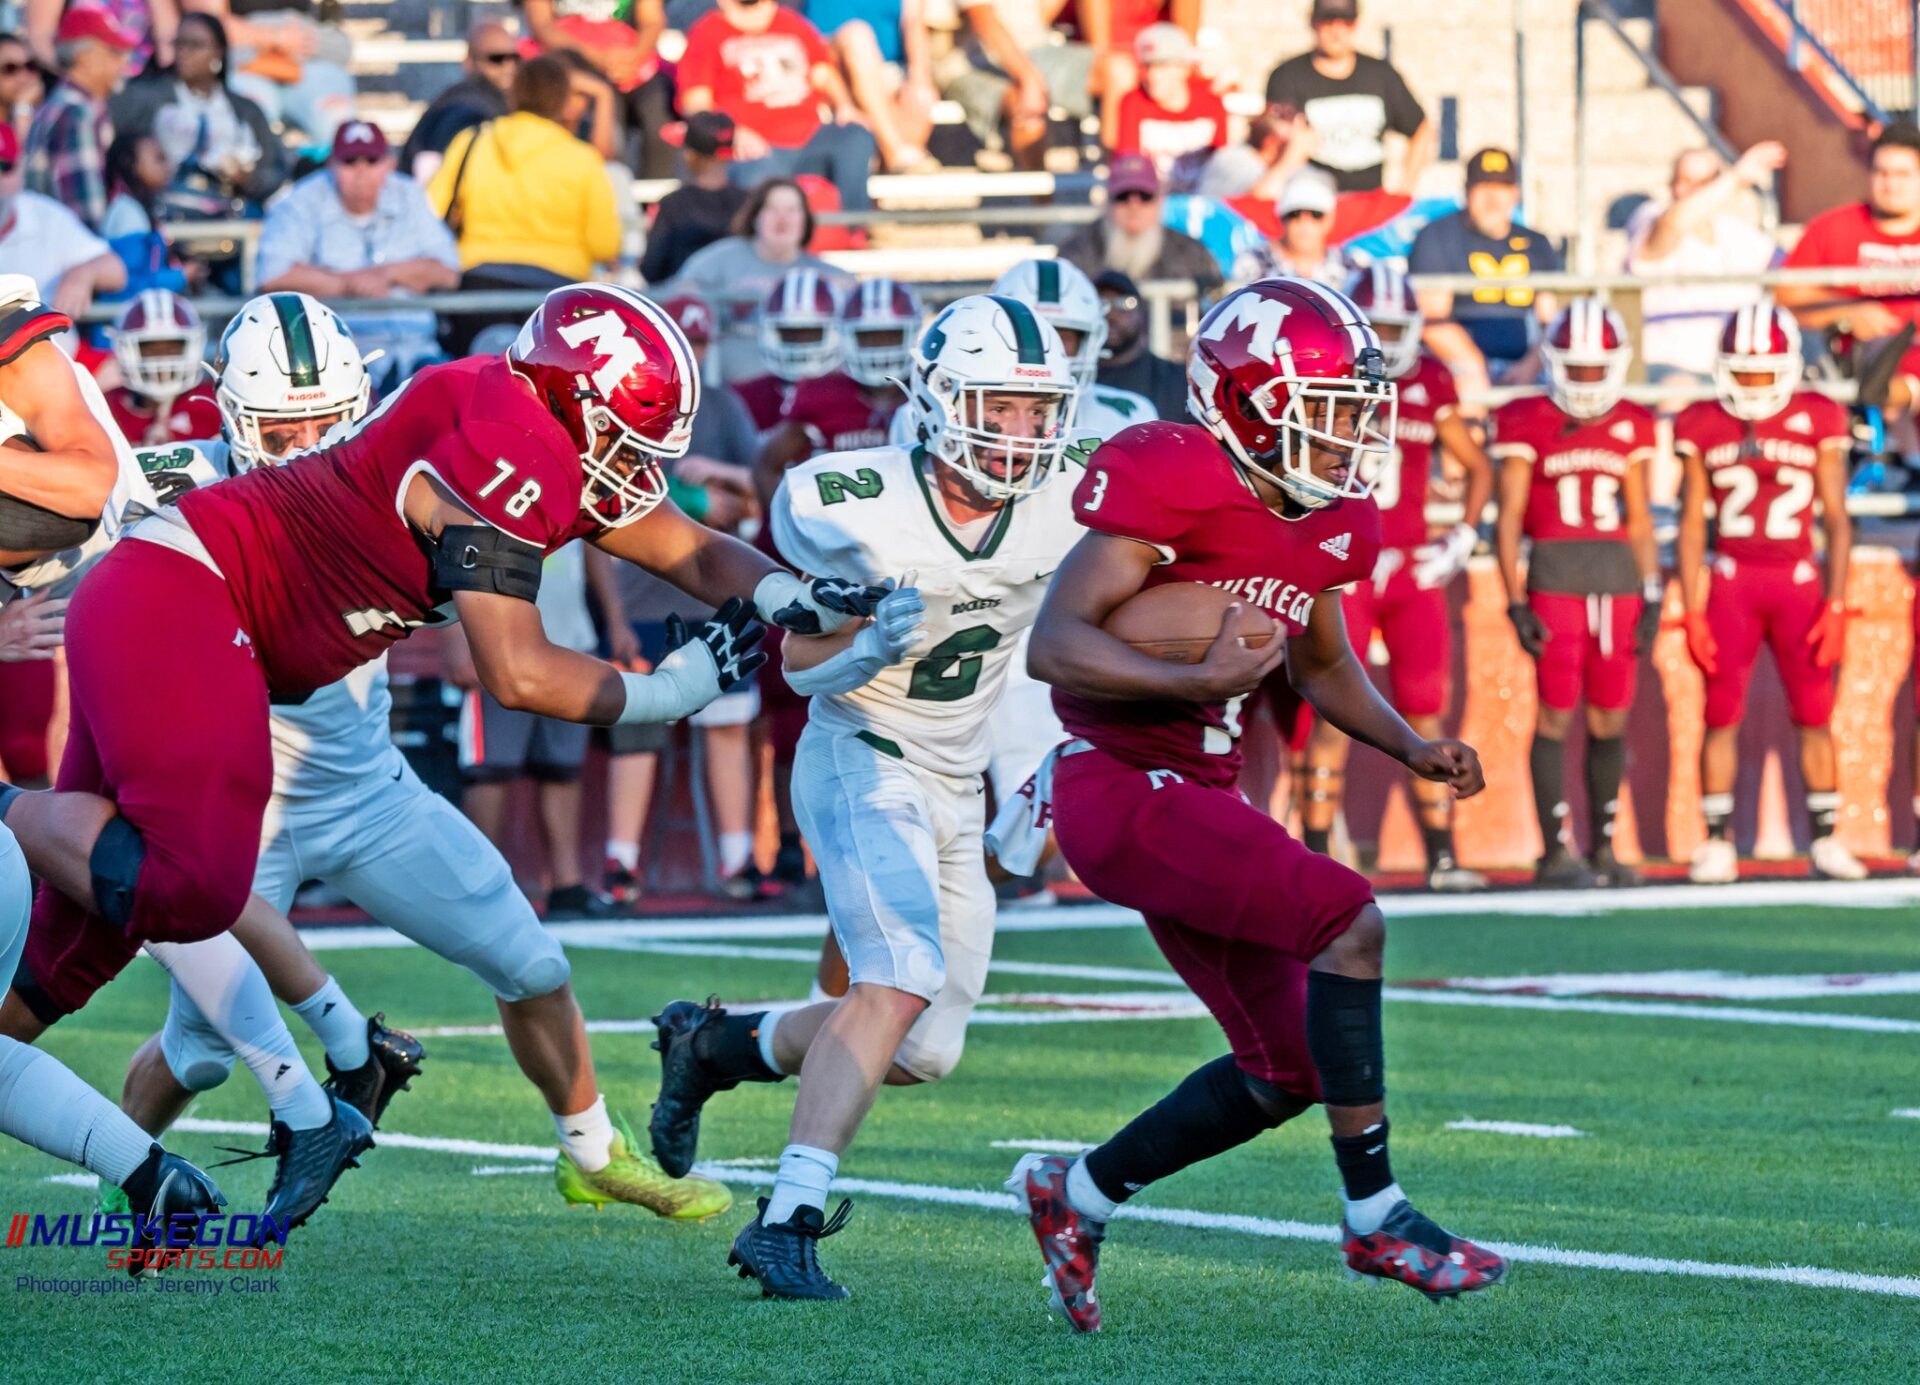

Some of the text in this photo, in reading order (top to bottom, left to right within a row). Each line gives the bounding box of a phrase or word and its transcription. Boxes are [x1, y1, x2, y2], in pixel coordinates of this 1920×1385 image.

[556, 309, 648, 403] M
[1200, 291, 1293, 366] M
[1704, 437, 1818, 469] MUEGON
[476, 457, 542, 519] 78
[814, 467, 884, 506] 2
[1082, 469, 1109, 512] 3
[1556, 473, 1620, 532] 15
[1711, 463, 1815, 540] 22
[1195, 576, 1315, 627] USKEGO
